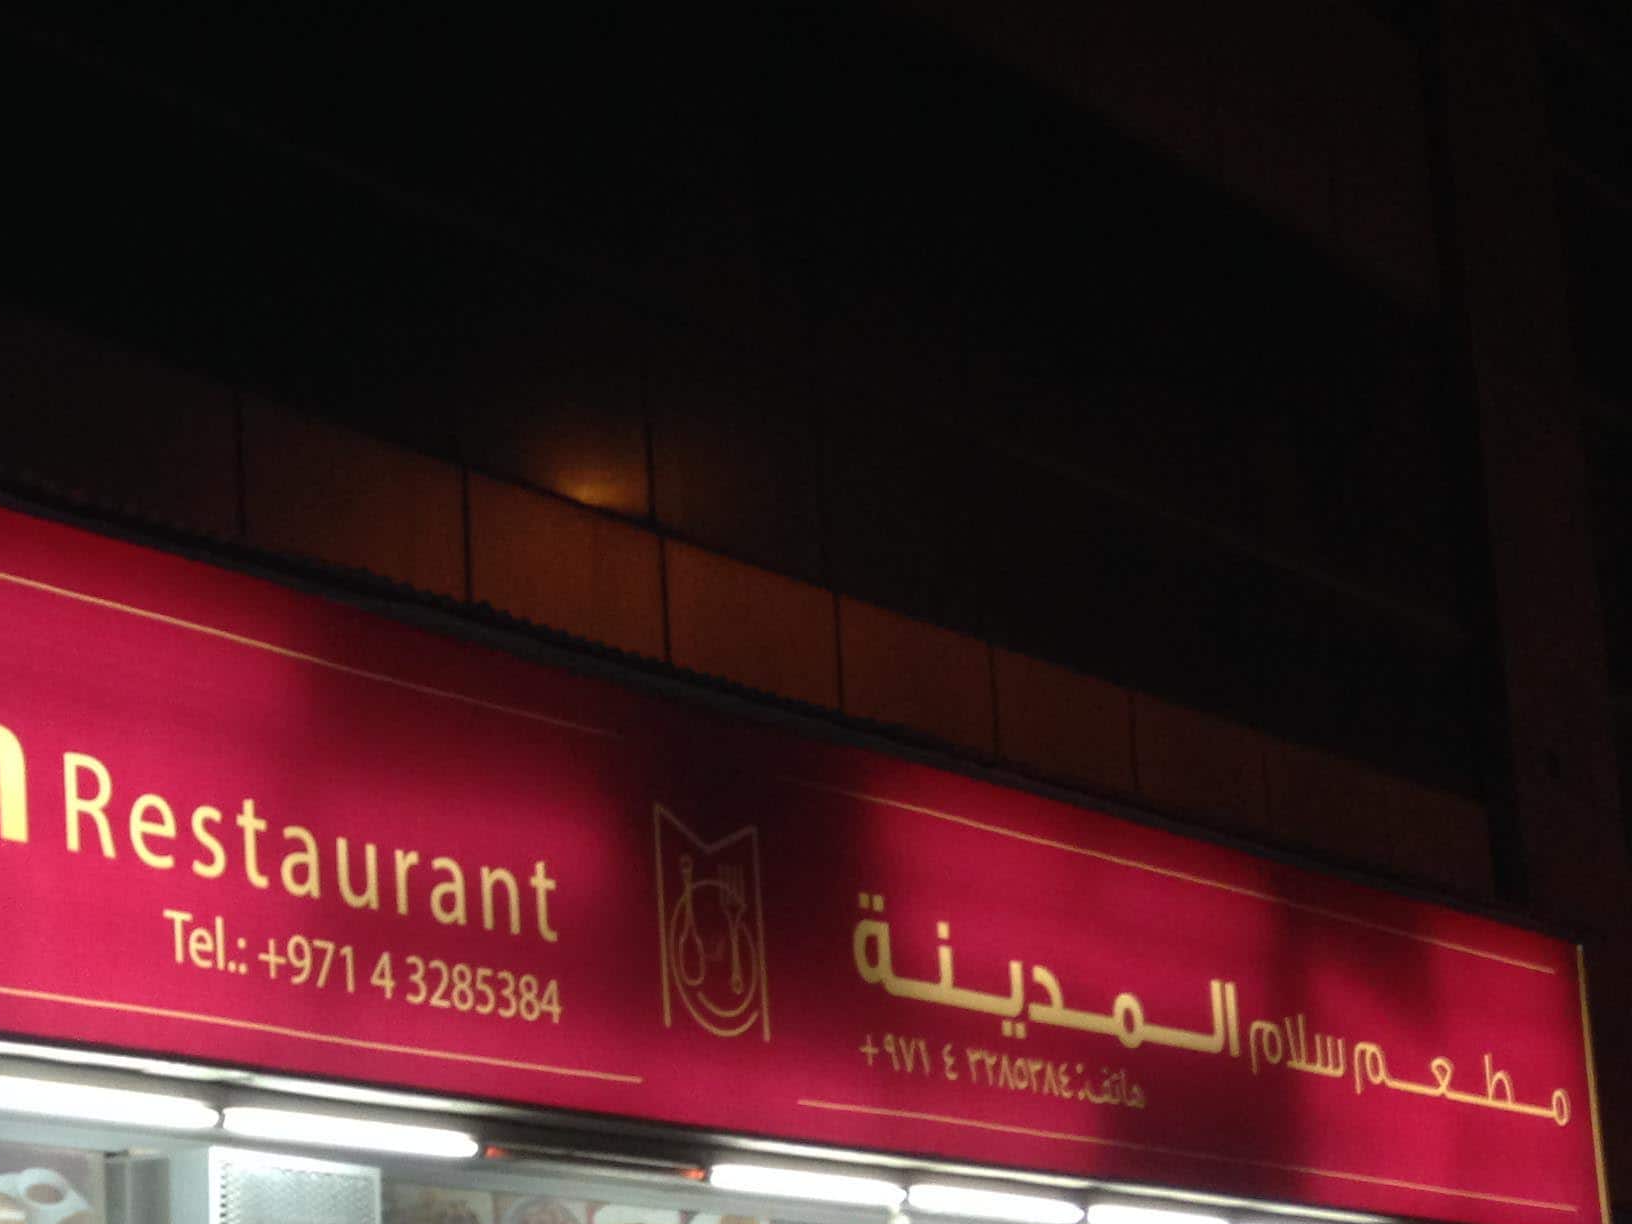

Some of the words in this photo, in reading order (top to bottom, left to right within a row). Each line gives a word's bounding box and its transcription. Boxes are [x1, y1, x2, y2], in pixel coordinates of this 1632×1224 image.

[62, 751, 559, 943] Restaurant
[162, 907, 249, 976] Tel.:
[257, 933, 356, 993] +971
[369, 951, 397, 1000] 4
[404, 955, 563, 1024] 3285384
[853, 892, 1241, 1058] المدينة
[1250, 1014, 1345, 1075] سلام
[1353, 1040, 1571, 1127] مطعم
